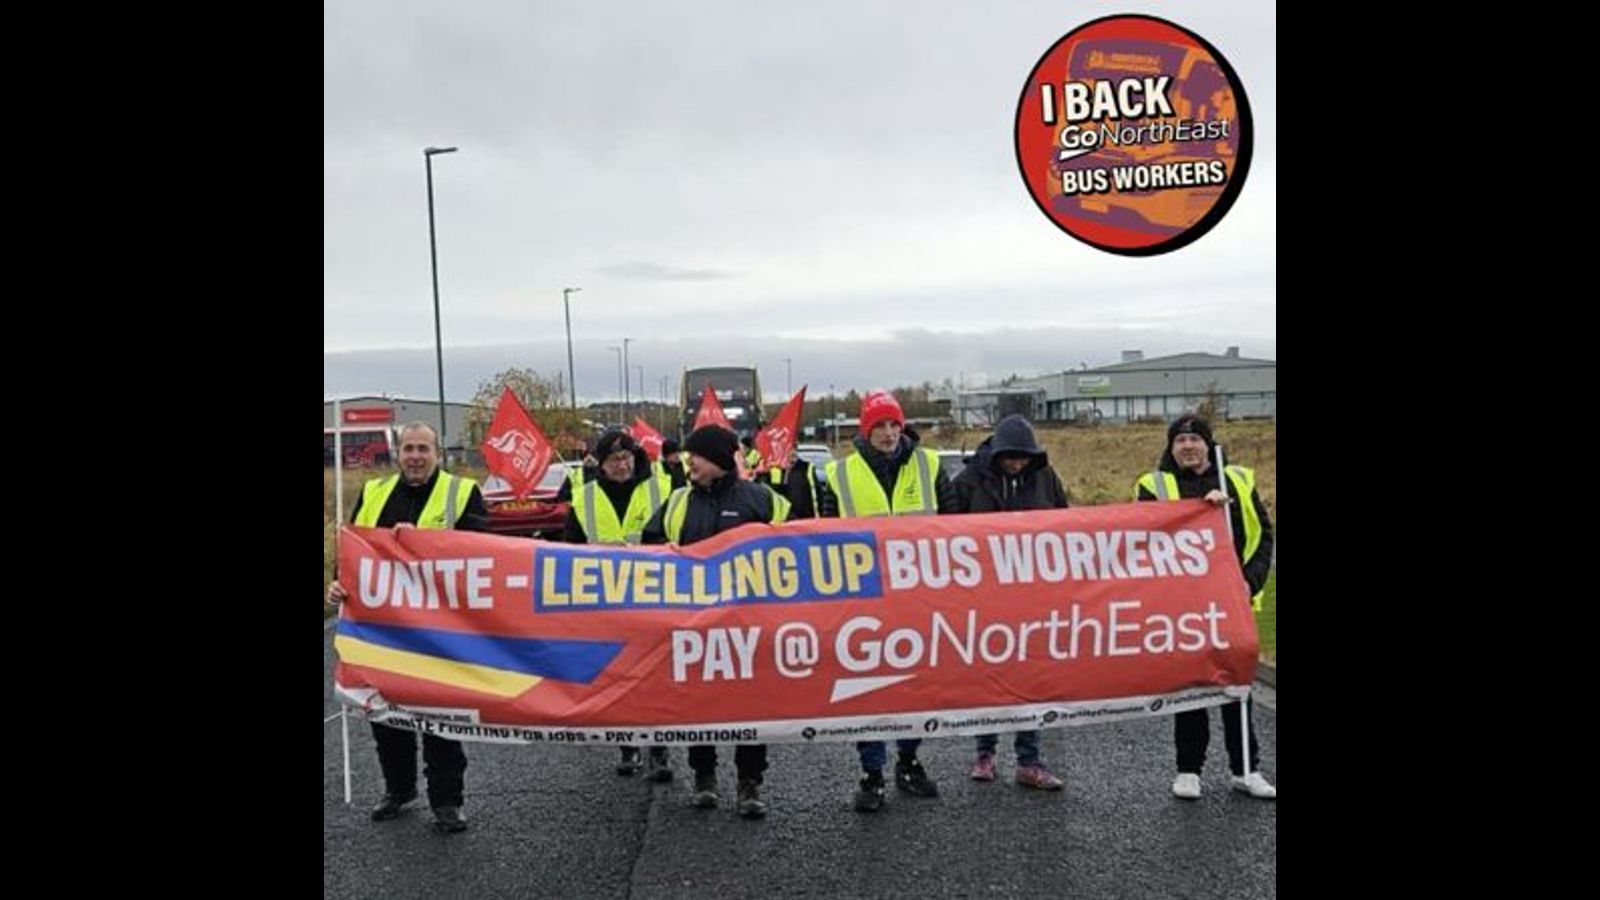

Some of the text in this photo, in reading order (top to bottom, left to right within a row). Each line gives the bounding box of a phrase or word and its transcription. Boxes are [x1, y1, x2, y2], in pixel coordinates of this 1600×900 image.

[359, 556, 494, 610] UNITE
[541, 546, 799, 606] LEVELLING
[808, 542, 875, 595] UP
[885, 536, 983, 590] BUS
[988, 529, 1215, 584] WORKERS’
[671, 600, 1230, 682] PAY @ GoNorthEast
[513, 729, 544, 742] FOR
[605, 730, 634, 742] PAY
[653, 728, 758, 743] CONDITIONS!
